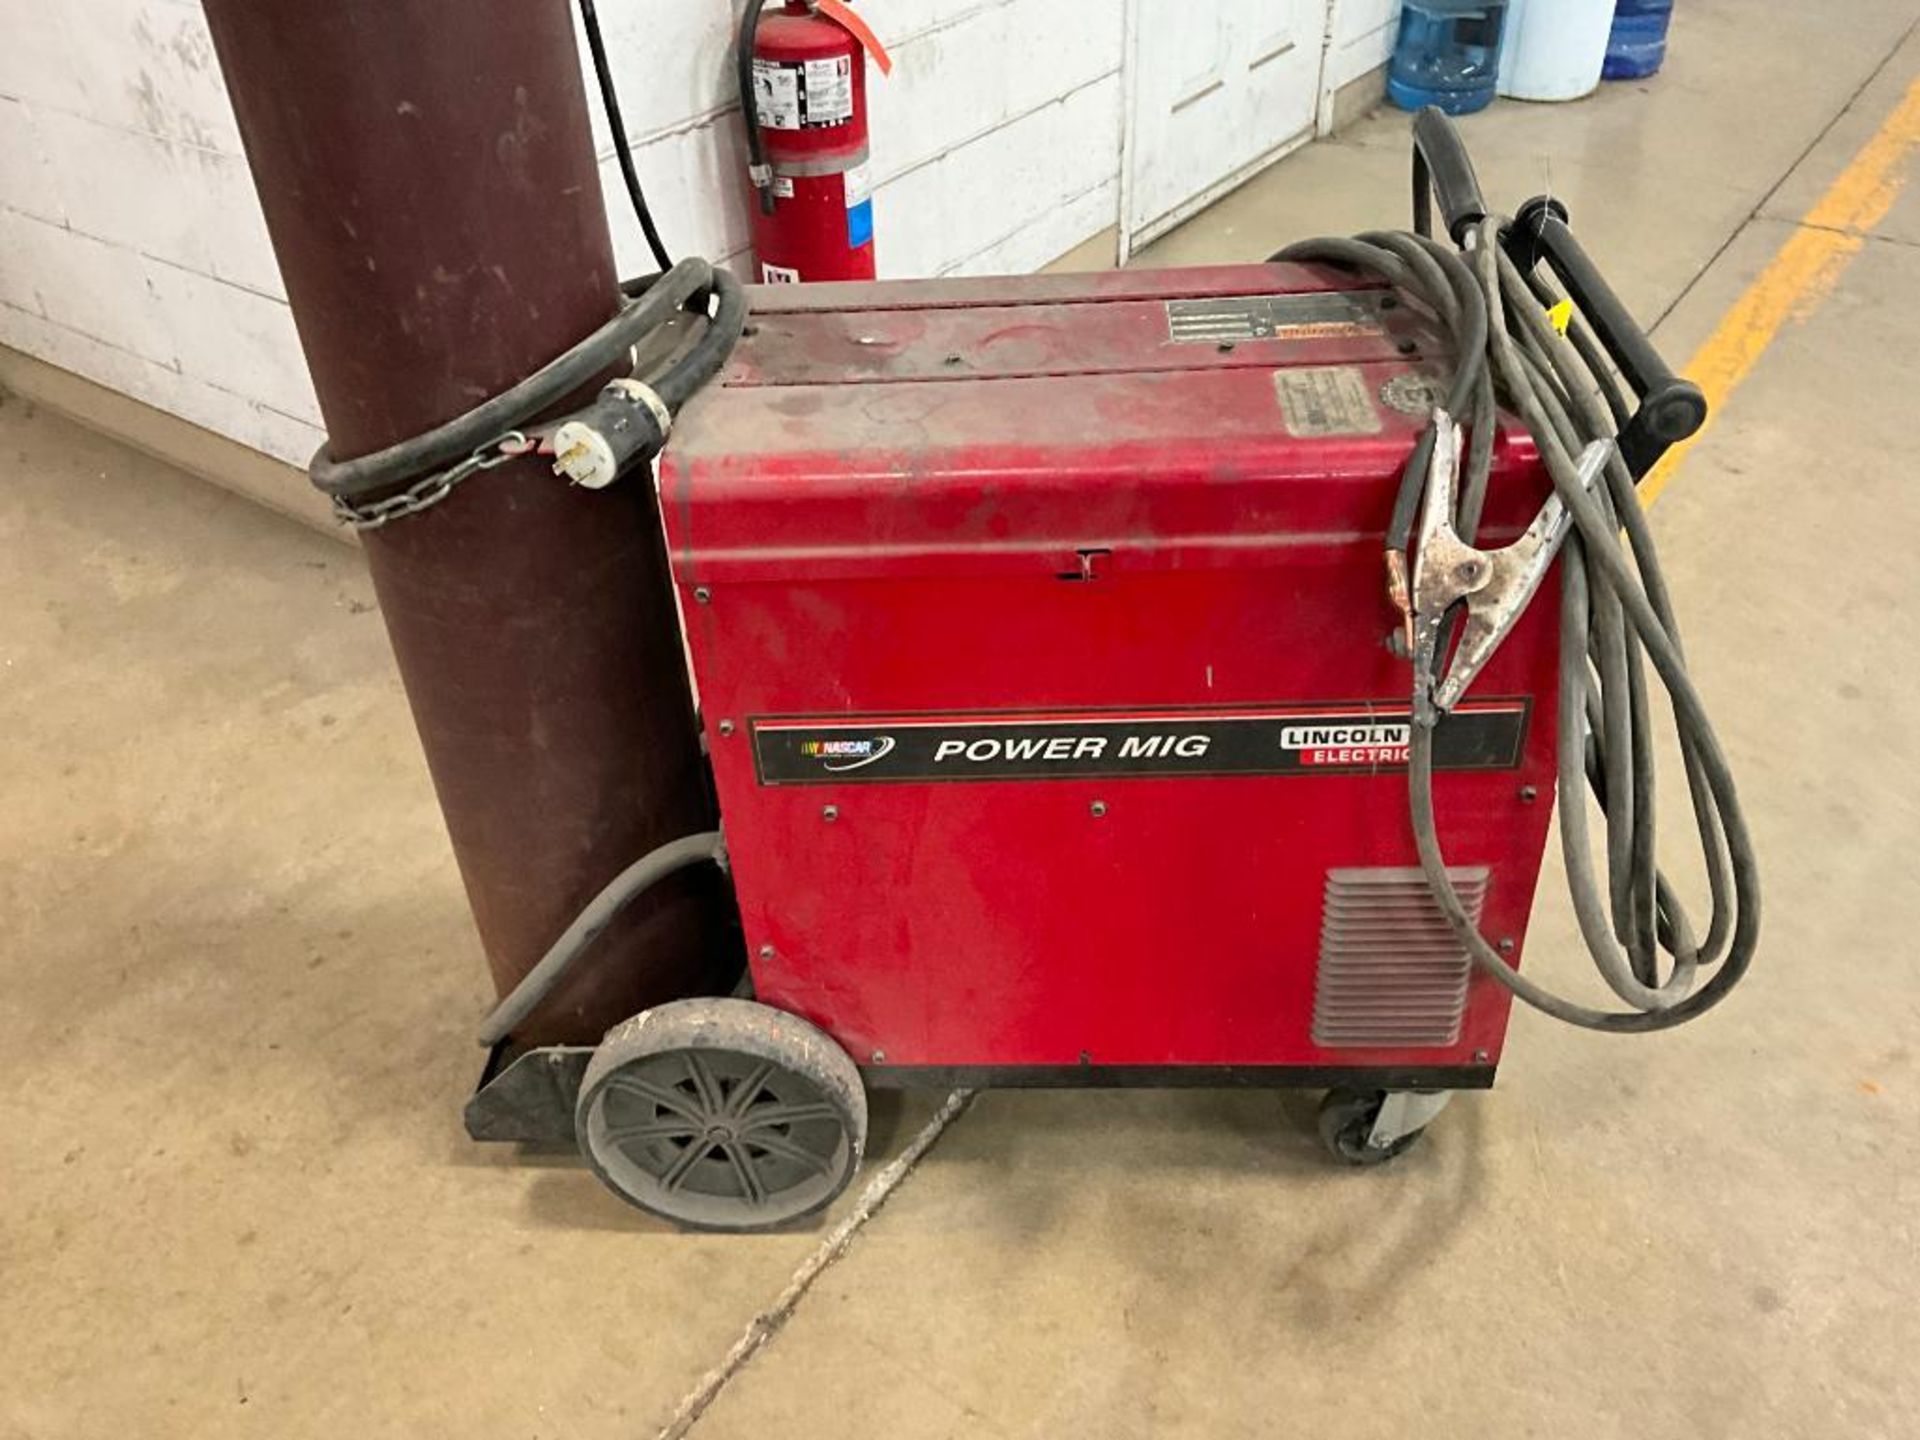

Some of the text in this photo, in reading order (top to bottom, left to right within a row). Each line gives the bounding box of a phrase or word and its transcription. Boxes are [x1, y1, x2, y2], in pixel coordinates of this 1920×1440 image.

[1288, 728, 1403, 745] LINCOLN
[823, 740, 872, 754] NASCAR
[933, 735, 1211, 762] POWER MIG
